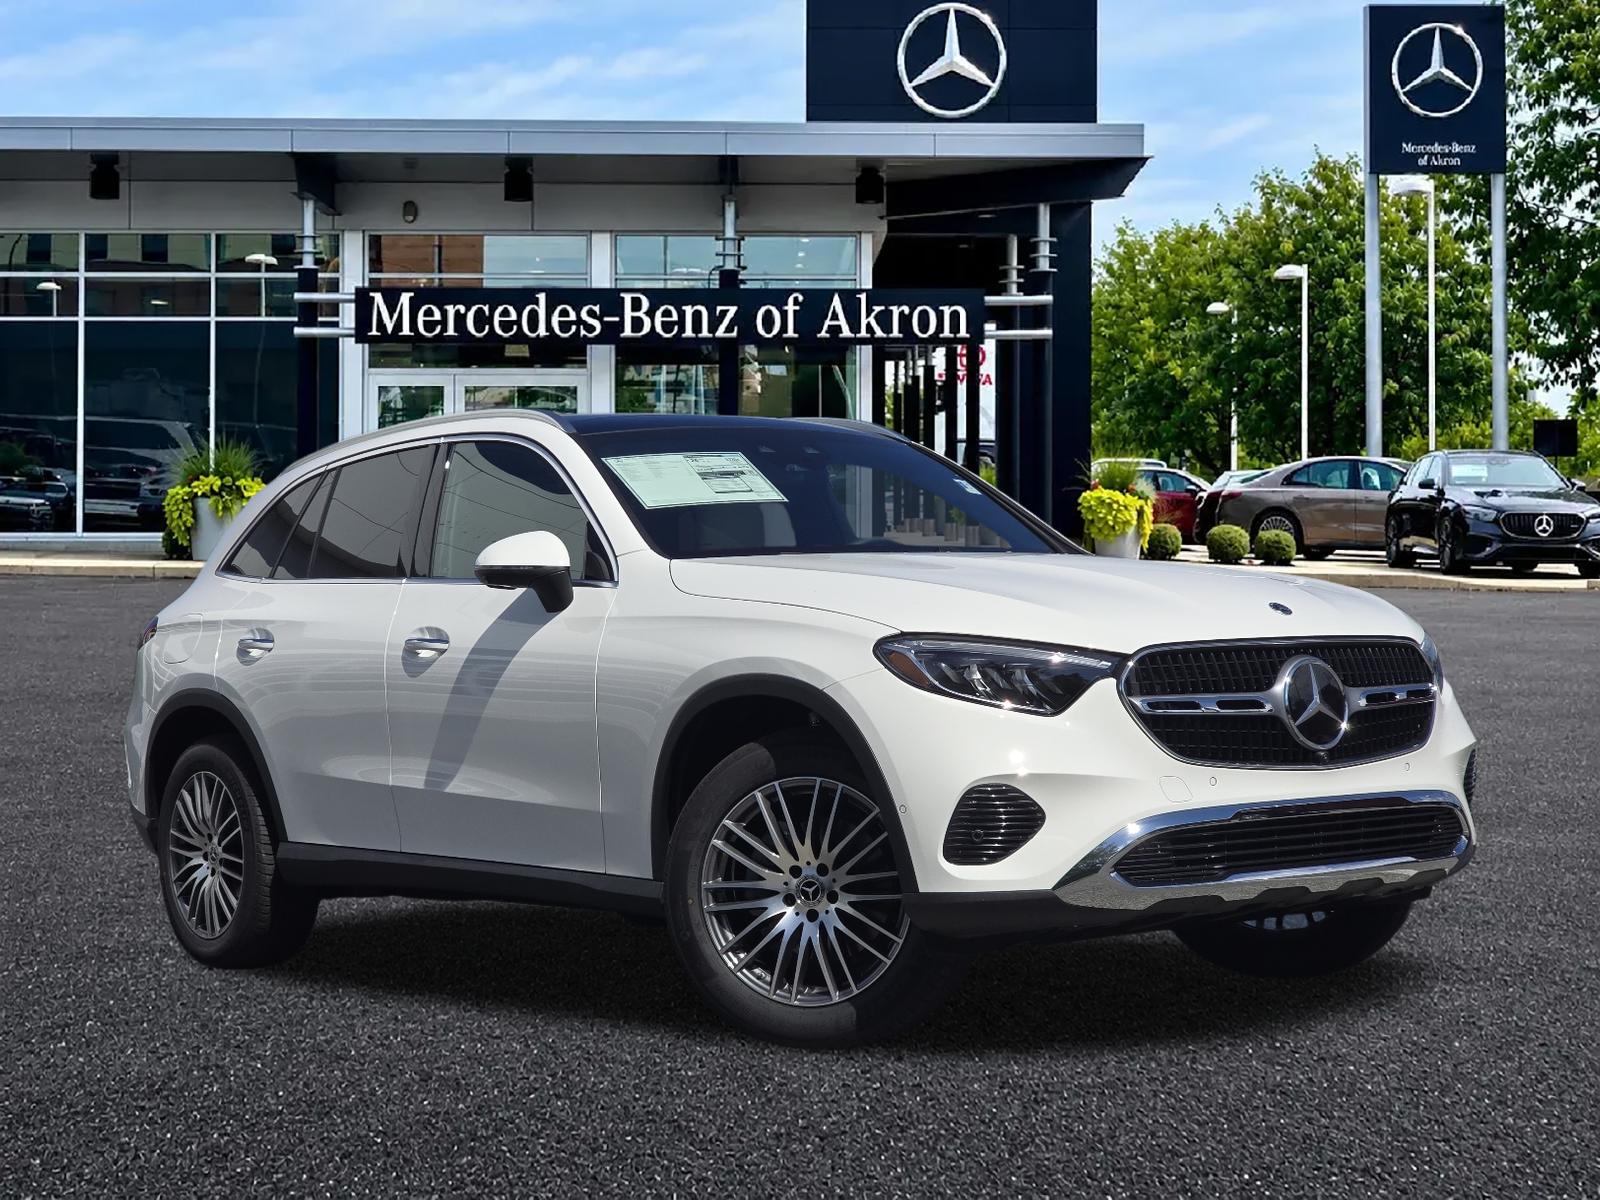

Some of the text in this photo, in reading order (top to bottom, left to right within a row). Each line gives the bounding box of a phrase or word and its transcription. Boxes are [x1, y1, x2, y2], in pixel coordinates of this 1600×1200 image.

[1401, 141, 1477, 154] Mercedes-Benz
[1417, 154, 1461, 166] of Akron
[367, 291, 971, 339] Mercedes-Benz of Akron
